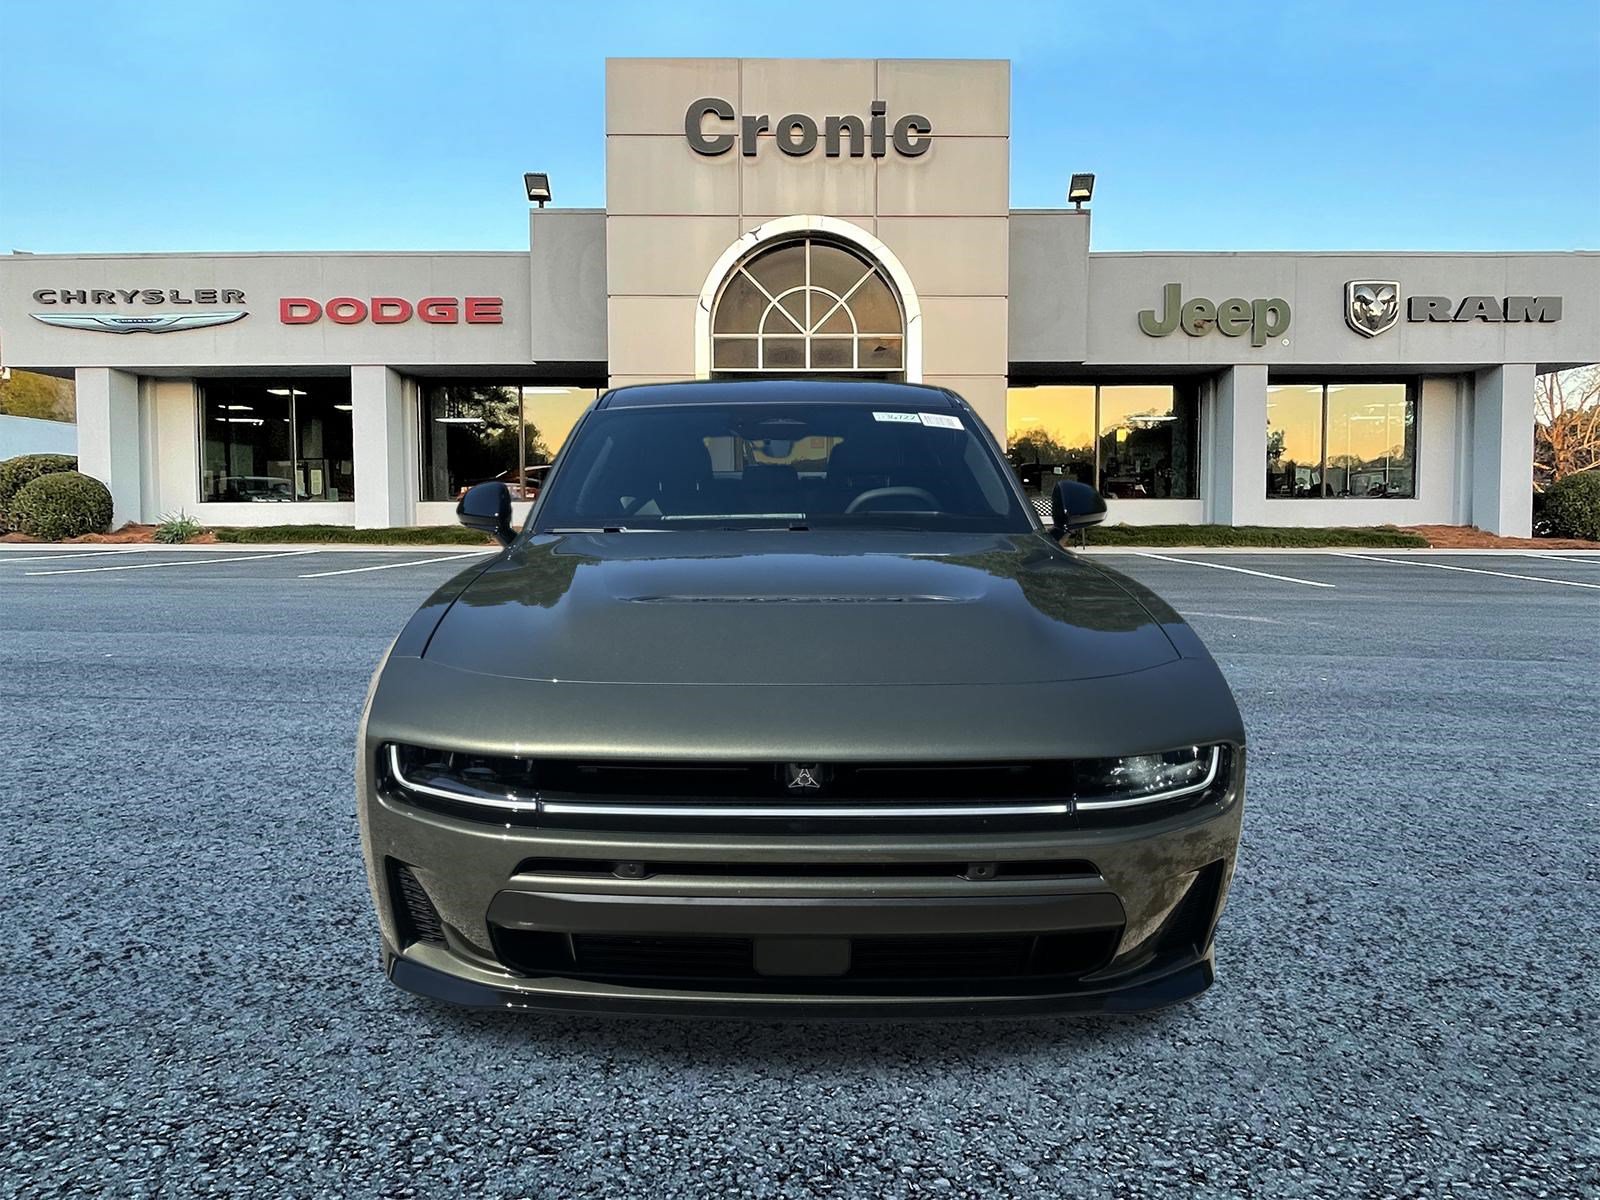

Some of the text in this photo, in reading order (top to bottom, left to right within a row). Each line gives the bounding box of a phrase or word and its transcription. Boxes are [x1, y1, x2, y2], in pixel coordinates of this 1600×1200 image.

[685, 97, 932, 157] Cronic
[32, 289, 246, 304] CHRYSLER
[1407, 296, 1563, 322] RAM
[280, 297, 503, 324] DODGE
[1138, 283, 1291, 347] Jeep
